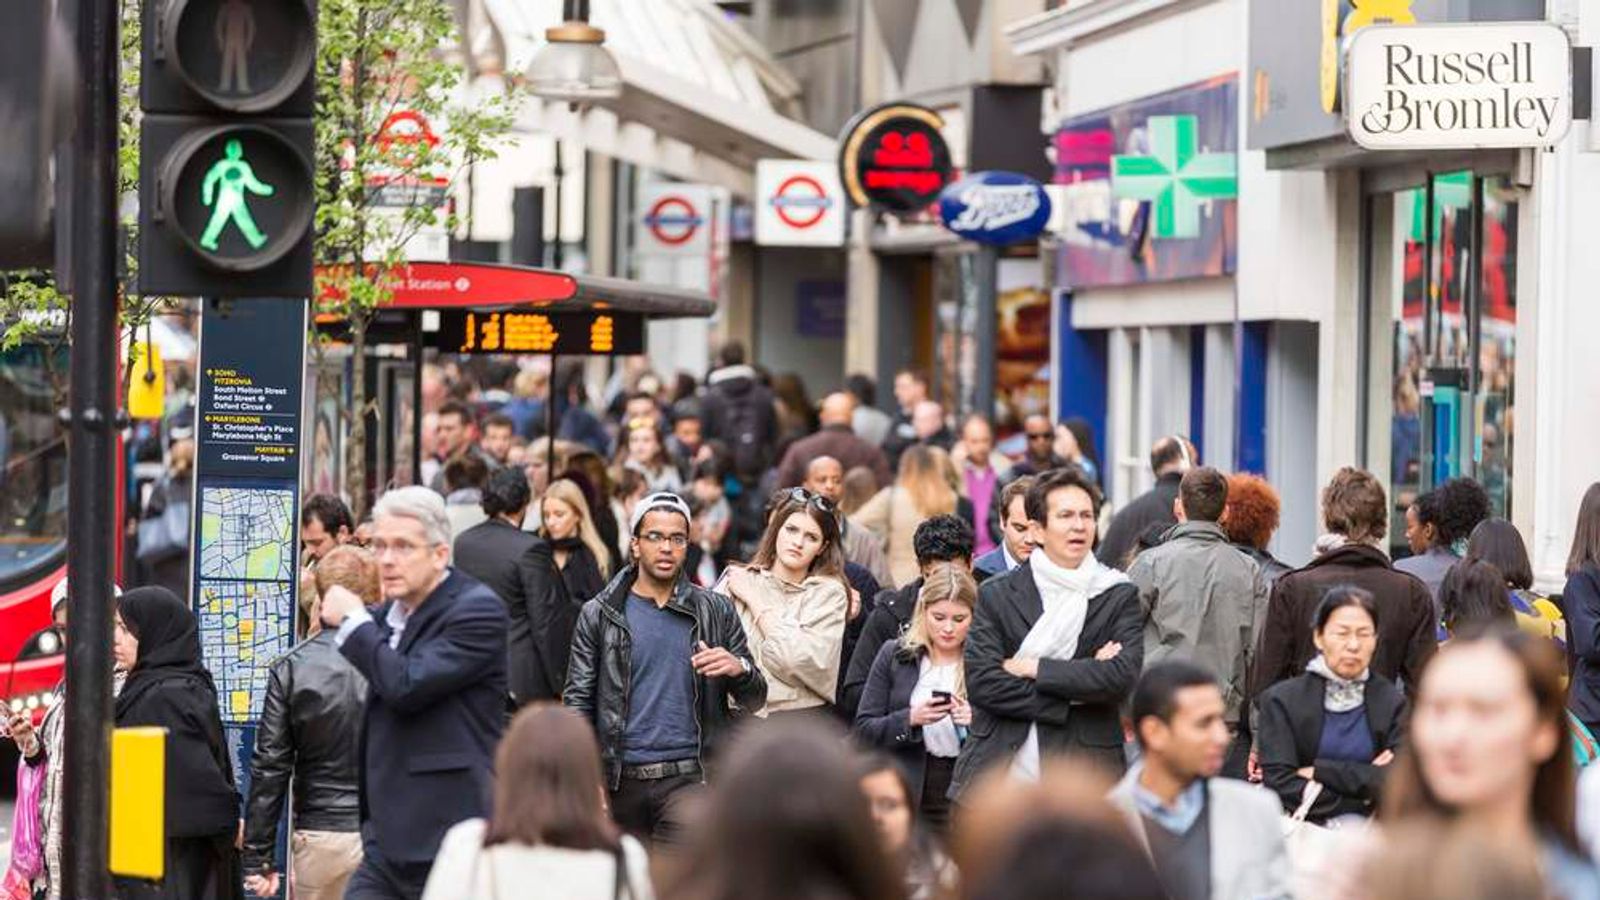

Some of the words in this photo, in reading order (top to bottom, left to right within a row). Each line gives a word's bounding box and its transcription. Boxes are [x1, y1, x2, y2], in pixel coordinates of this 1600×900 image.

[1383, 42, 1534, 86] Russell
[408, 279, 452, 290] Station
[213, 402, 239, 410] Oxford
[212, 415, 261, 423] MARYLEBONE
[224, 425, 272, 433] Christopher's
[212, 432, 254, 440] Marylebone
[255, 433, 273, 441] High
[222, 453, 259, 461] Grosvenor
[260, 454, 286, 462] Square
